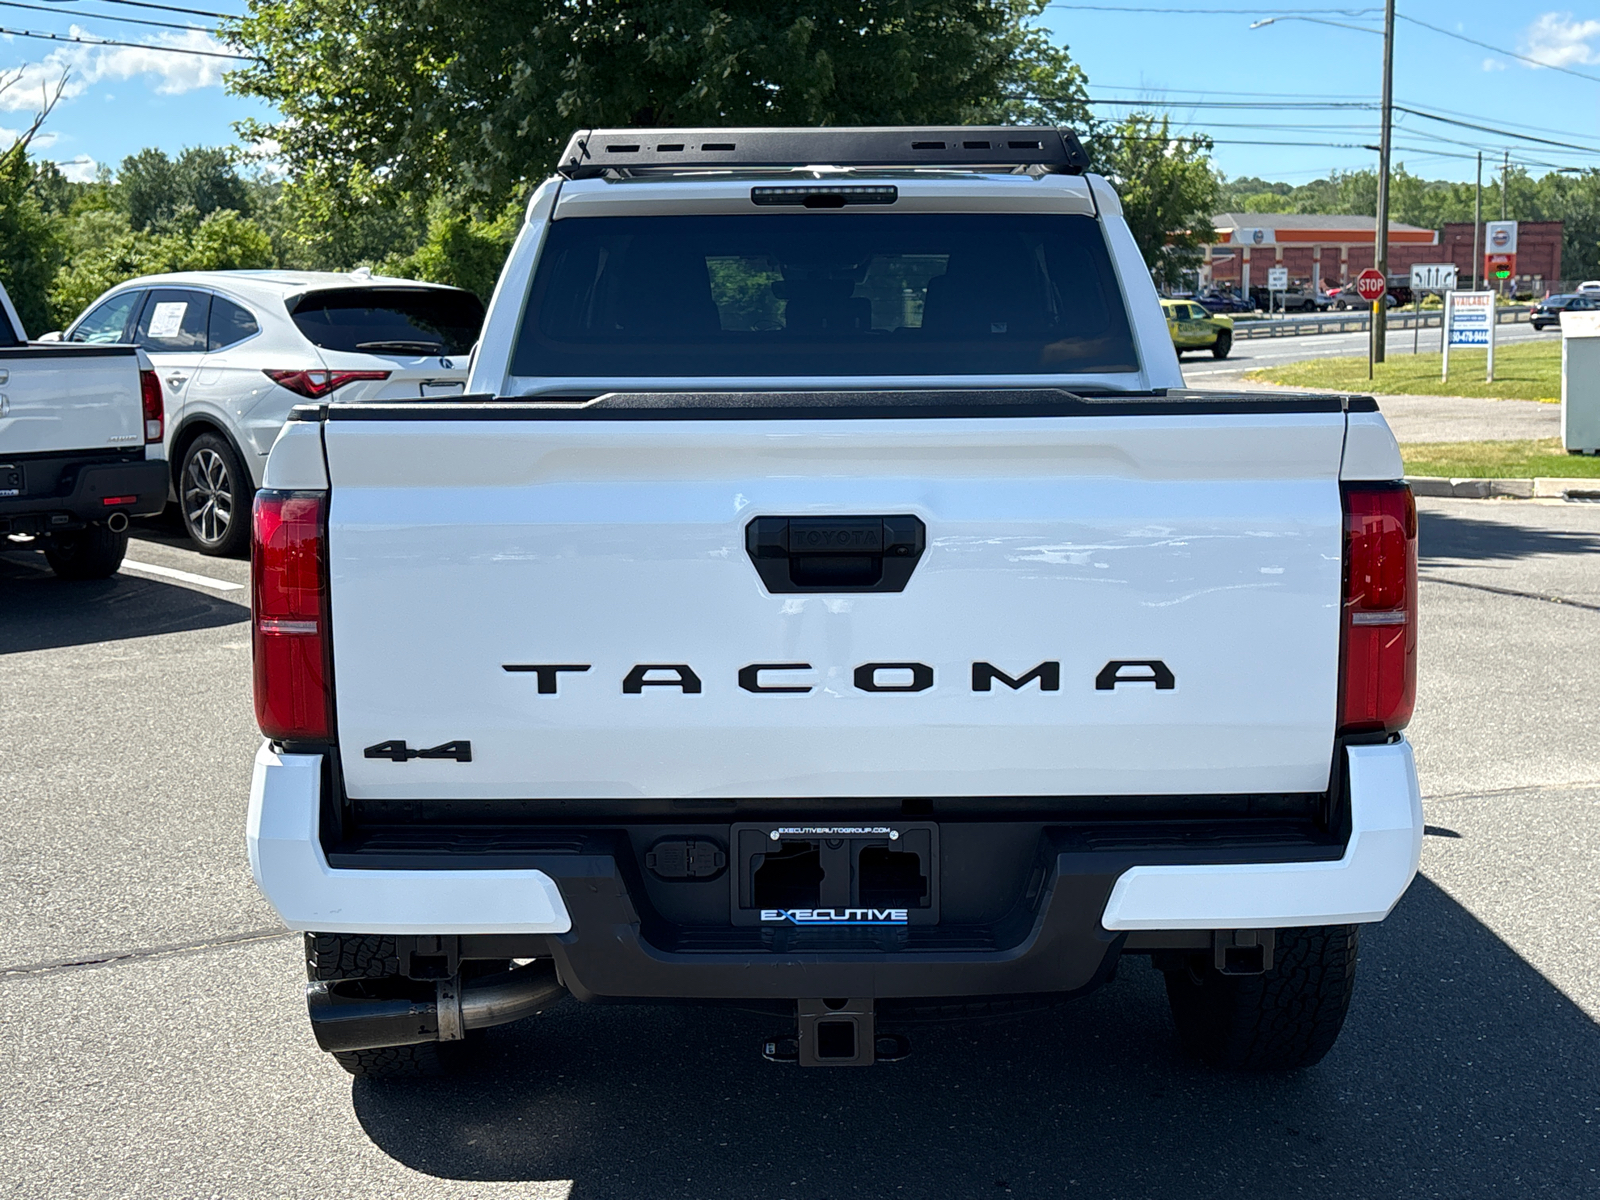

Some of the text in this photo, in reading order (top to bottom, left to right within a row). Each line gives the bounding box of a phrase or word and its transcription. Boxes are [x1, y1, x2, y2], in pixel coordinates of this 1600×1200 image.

[1358, 278, 1384, 292] STOP
[1450, 295, 1490, 306] AVAILABLE
[794, 530, 878, 546] TOYOTA
[502, 660, 1176, 695] TACOMA
[778, 827, 891, 835] EXECUTIVEAUTOGROUP.COM
[760, 908, 908, 922] EXECUTIVE
